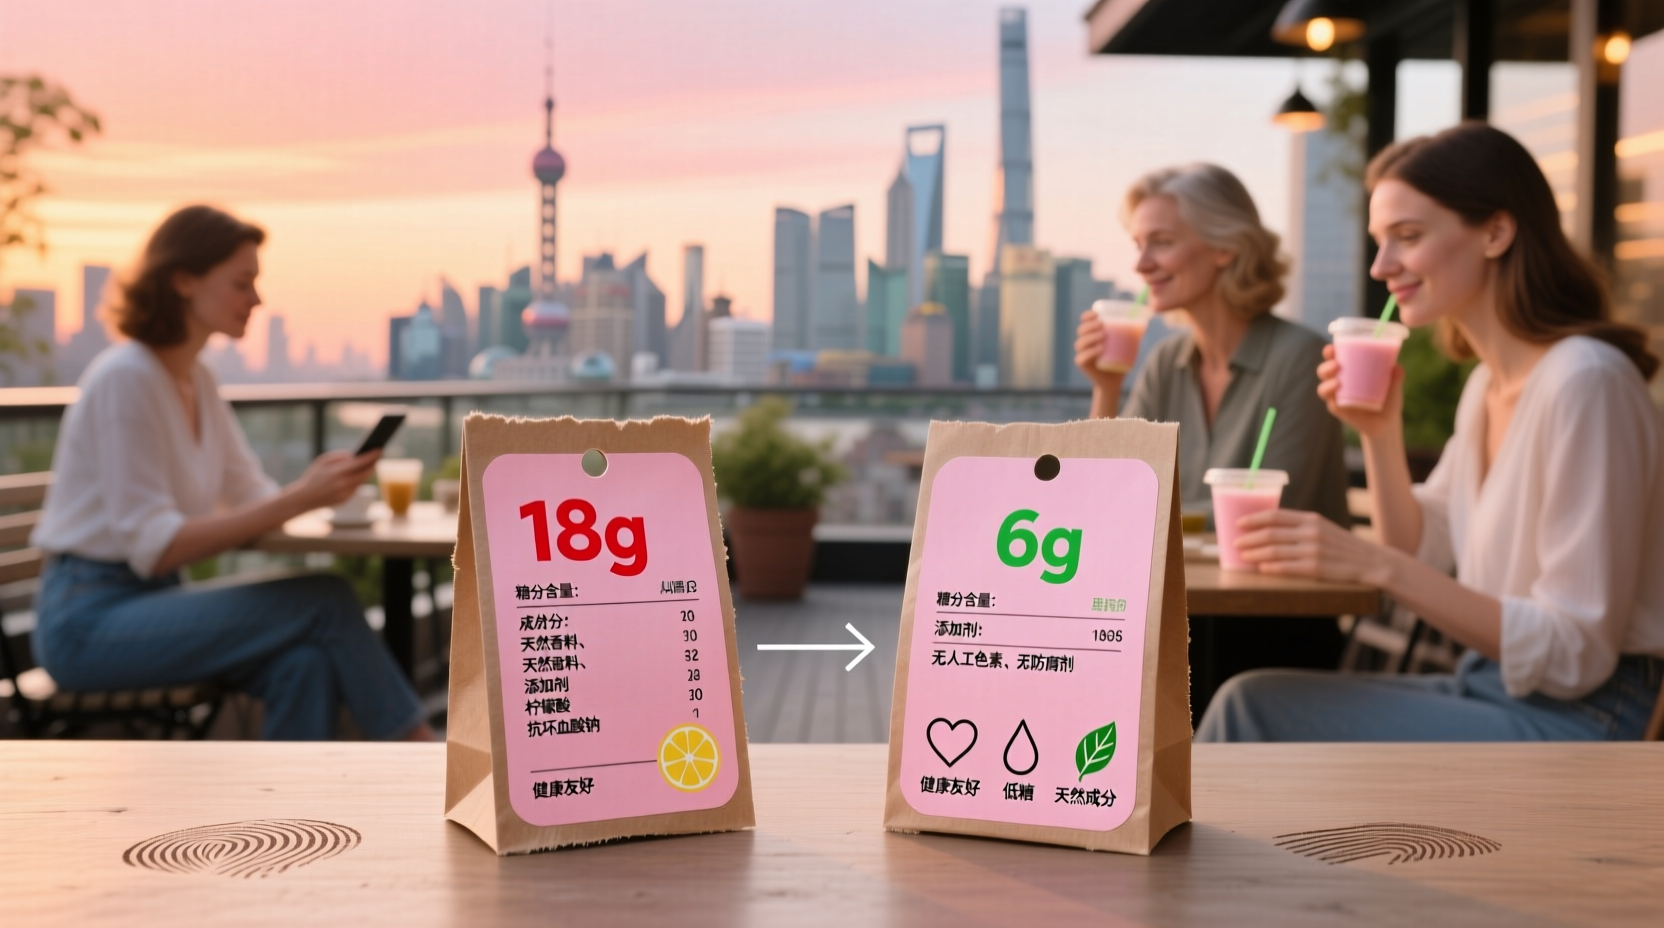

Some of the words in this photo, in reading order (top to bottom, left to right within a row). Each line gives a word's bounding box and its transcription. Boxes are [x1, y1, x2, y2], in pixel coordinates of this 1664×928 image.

[519, 498, 648, 577] 18g
[996, 508, 1083, 584] 6g
[532, 776, 595, 800] 健康友好
[920, 775, 981, 797] 健康友好
[1002, 781, 1035, 802] 低糖
[1054, 786, 1117, 808] 天然成分
